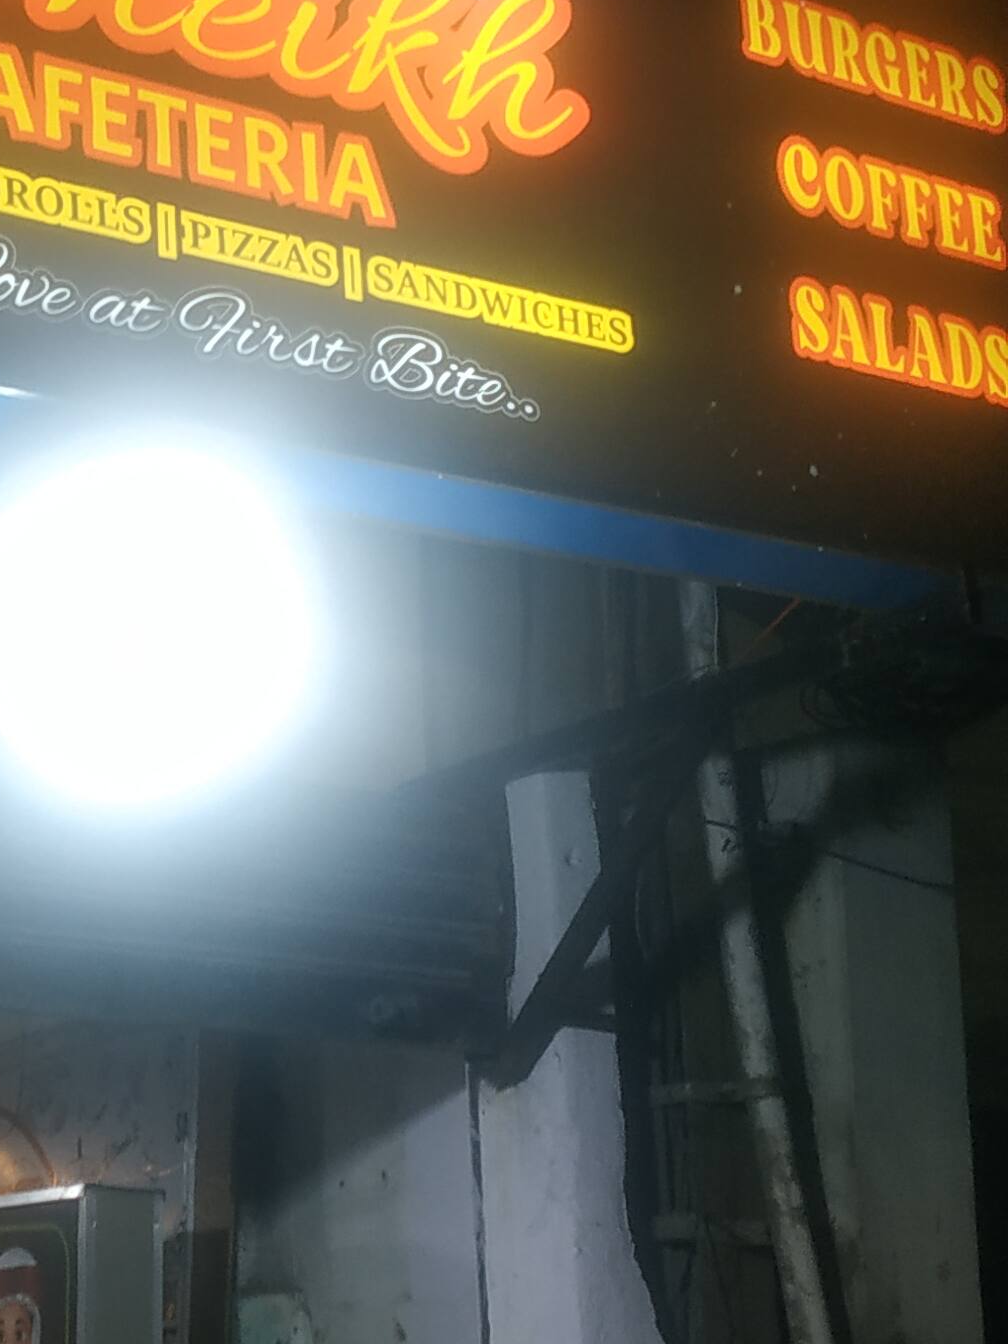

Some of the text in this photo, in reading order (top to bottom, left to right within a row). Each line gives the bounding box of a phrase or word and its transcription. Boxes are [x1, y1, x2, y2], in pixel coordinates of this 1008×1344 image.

[0, 172, 148, 239] ROLLS
[189, 213, 335, 283] PIZZAS
[370, 259, 630, 349] SANDWICHES
[780, 139, 1004, 265] COFFEE
[88, 293, 166, 333] at
[178, 292, 357, 373] First
[792, 279, 1008, 404] SALADS
